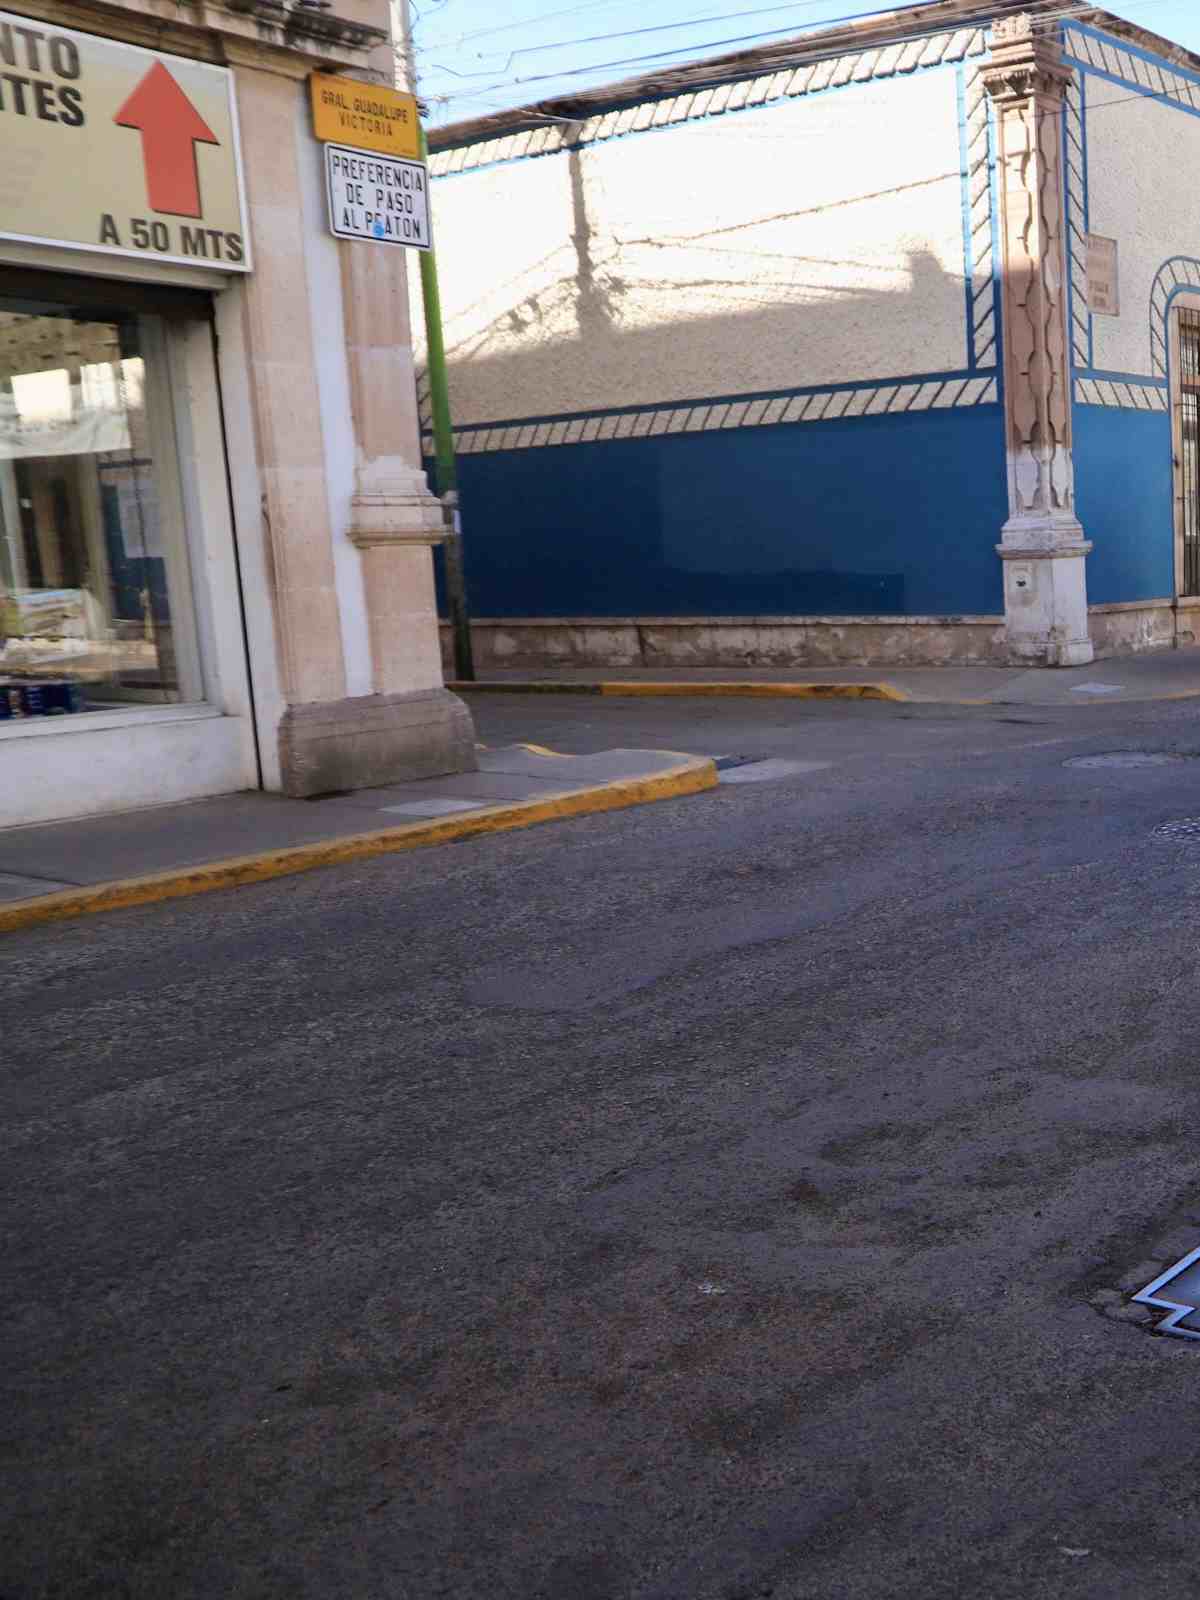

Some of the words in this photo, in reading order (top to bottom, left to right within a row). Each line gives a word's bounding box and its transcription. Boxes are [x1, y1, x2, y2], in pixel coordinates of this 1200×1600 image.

[0, 72, 84, 127] TES
[353, 97, 409, 124] GUADALUPE
[338, 111, 393, 136] VICTORIA
[332, 155, 423, 192] PREFERENCIA
[346, 183, 364, 206] DE
[376, 189, 413, 214] PASO
[343, 207, 360, 230] AL
[100, 213, 121, 246] A
[131, 217, 169, 252] 50
[180, 225, 243, 262] MTS
